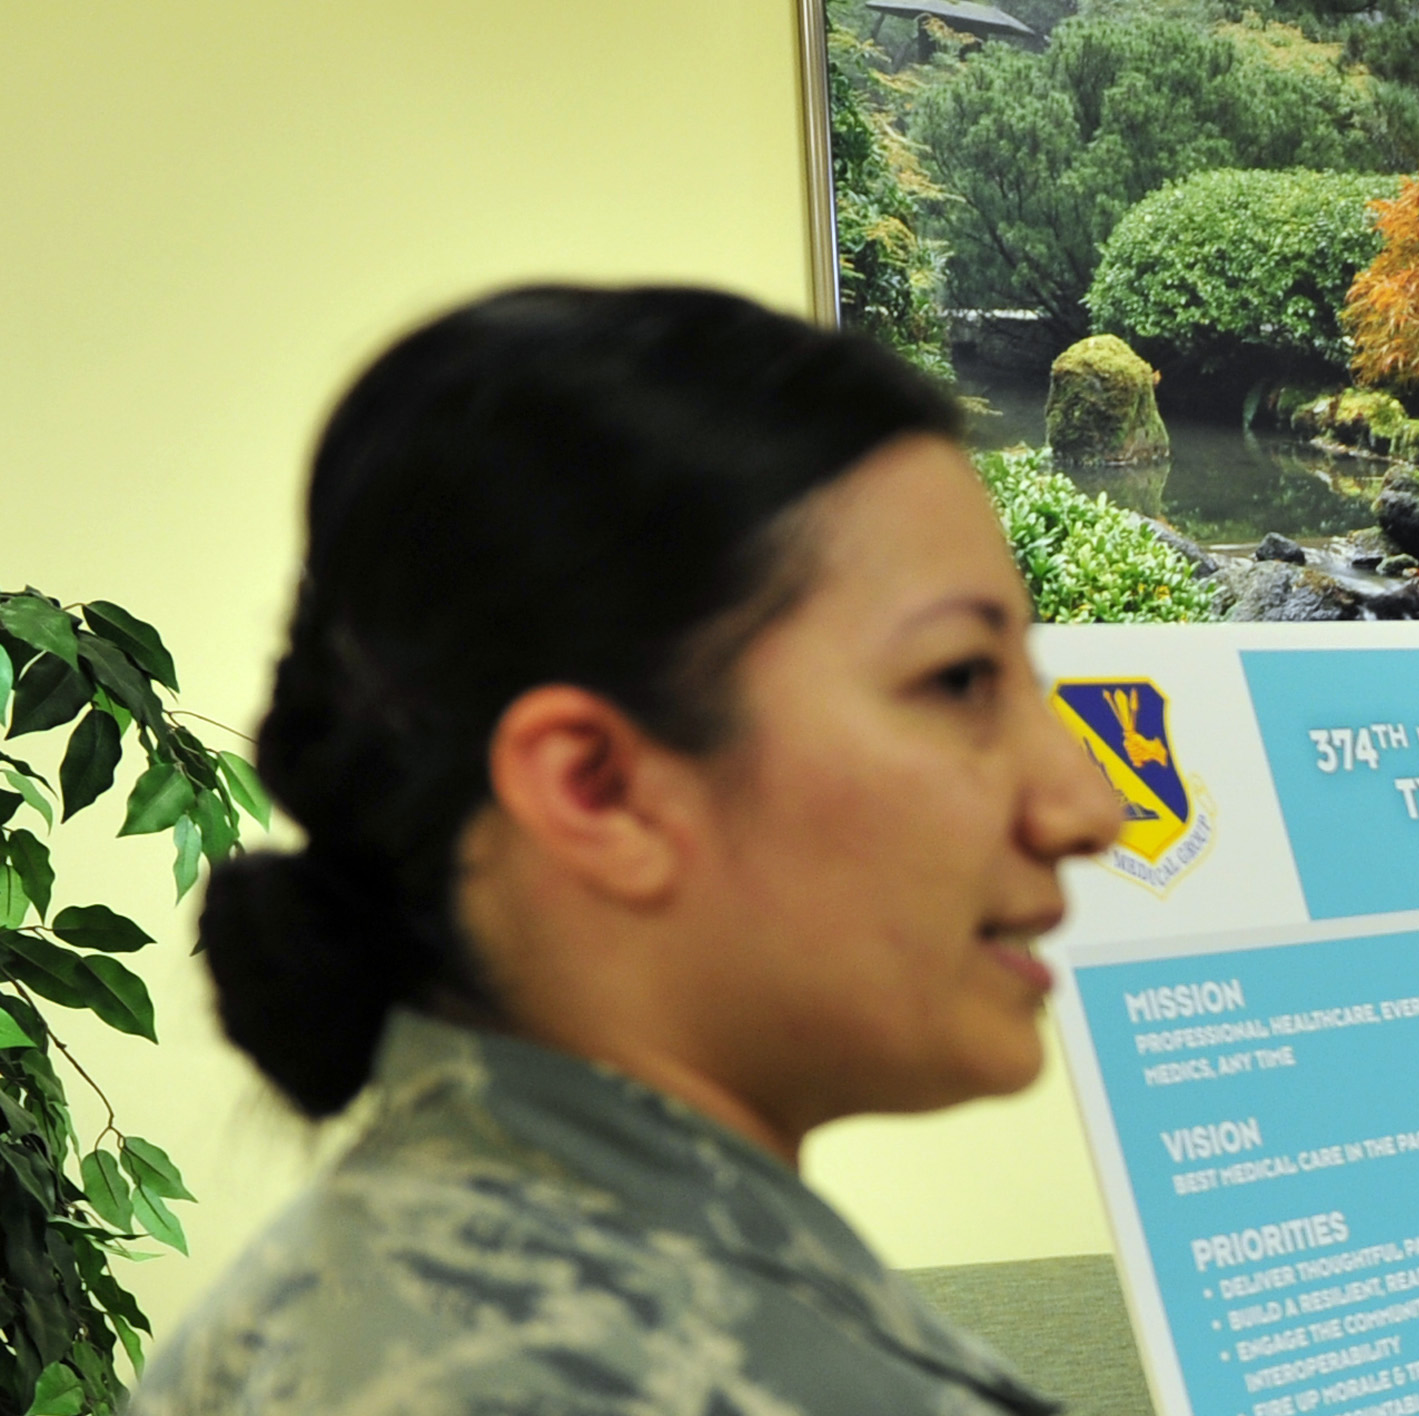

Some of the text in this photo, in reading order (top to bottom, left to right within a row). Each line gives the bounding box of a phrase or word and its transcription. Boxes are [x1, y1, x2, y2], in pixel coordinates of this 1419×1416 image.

[1309, 723, 1408, 774] 374TH
[1124, 980, 1246, 1023] MISSION
[1134, 1019, 1269, 1055] PROFESSIONAL
[1269, 1004, 1381, 1037] HEALTHCARE,
[1143, 1046, 1295, 1087] MEDICS, ANY TIME
[1160, 1116, 1262, 1163] VISION
[1172, 1169, 1218, 1196] BEST
[1220, 1155, 1298, 1187] MEDICAL
[1298, 1146, 1344, 1172] CARE
[1345, 1143, 1362, 1162] IN
[1362, 1135, 1396, 1159] THE
[1191, 1210, 1349, 1271] PRIORITIES
[1219, 1265, 1296, 1299] DELIVER
[1295, 1244, 1403, 1283] THOUGHTFUL
[1227, 1302, 1283, 1331] BUILD
[1284, 1297, 1299, 1317] A
[1300, 1278, 1387, 1314] RESILIENT,
[1236, 1328, 1308, 1362] ENGAGE
[1308, 1317, 1344, 1343] THE
[1245, 1336, 1400, 1393] INTEROPERABILITY
[1297, 1389, 1321, 1412] UP
[1321, 1372, 1393, 1407] MORALE
